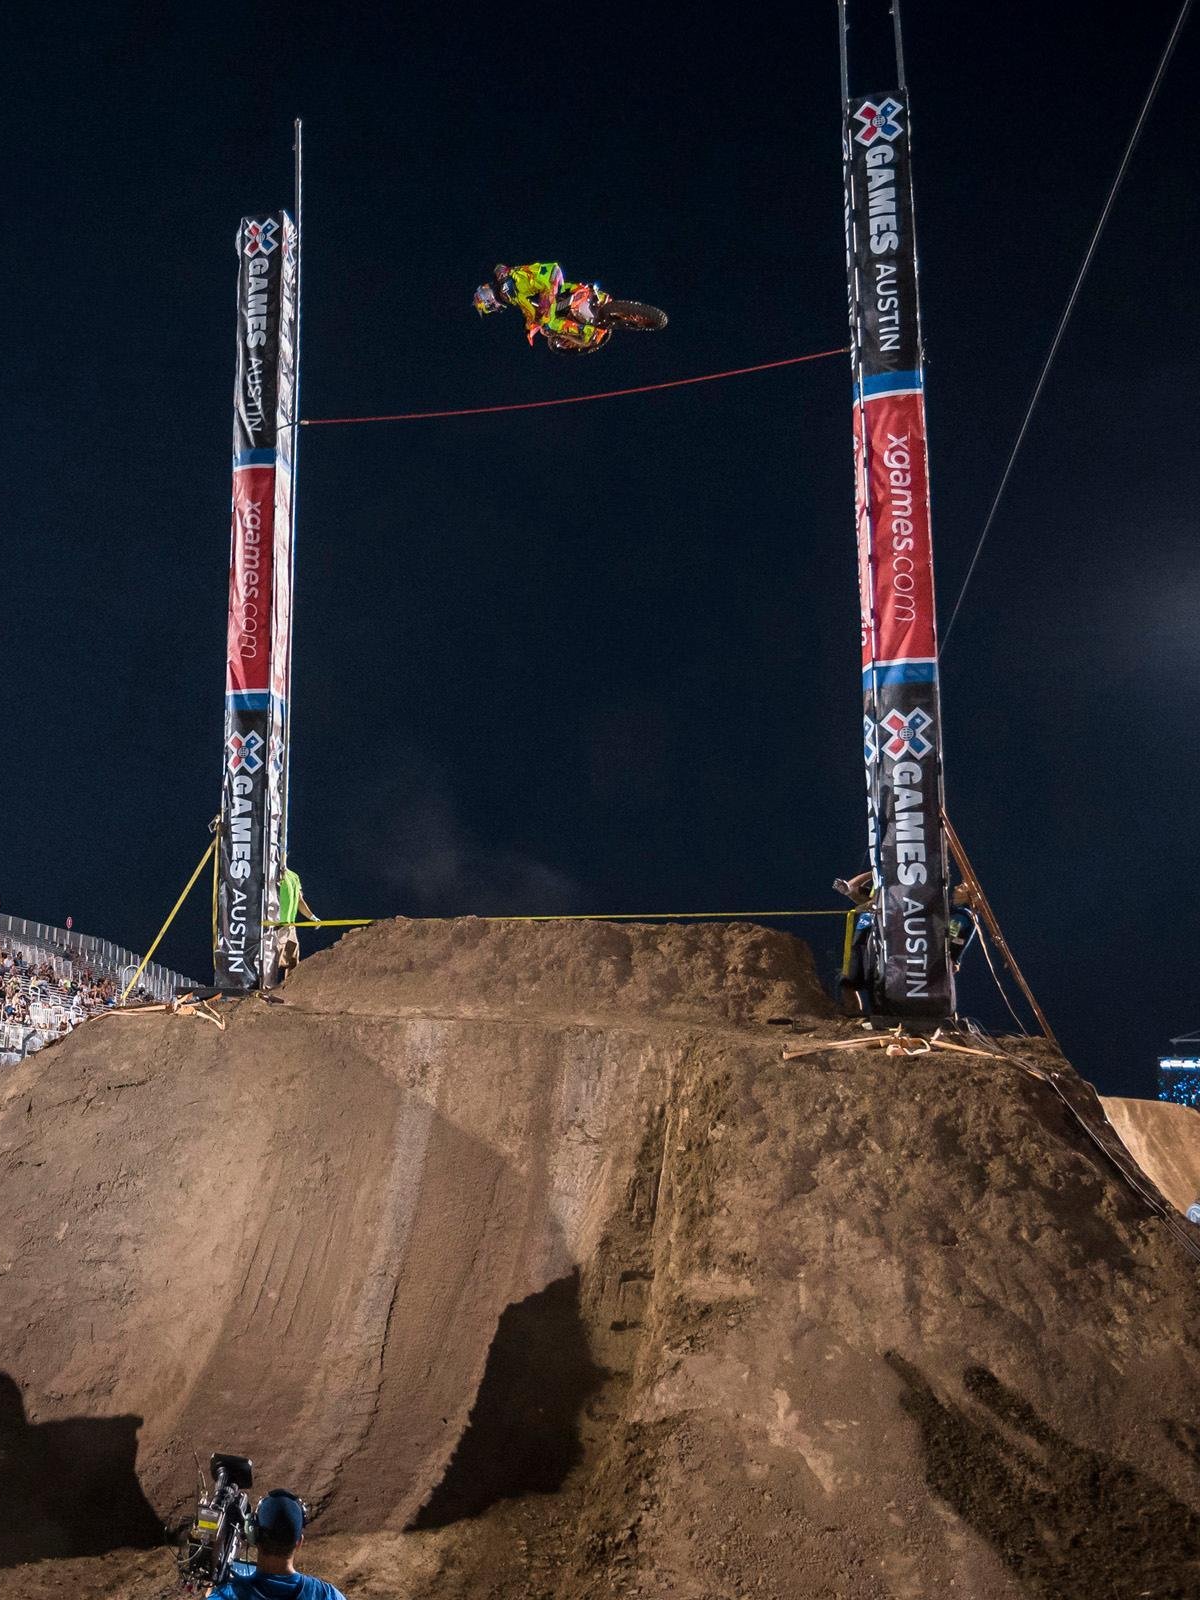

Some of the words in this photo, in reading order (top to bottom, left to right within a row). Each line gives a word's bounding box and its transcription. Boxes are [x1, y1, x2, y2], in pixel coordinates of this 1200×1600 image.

[865, 145, 899, 255] GAMES
[246, 257, 269, 349] GAMES
[876, 264, 900, 352] AUSTIN
[246, 358, 263, 432] AUSTIN
[883, 433, 916, 622] xgames.com
[230, 775, 253, 880] GAMES
[892, 761, 928, 887] GAMES
[228, 888, 248, 973] AUSTIN
[903, 897, 929, 998] AUSTIN
